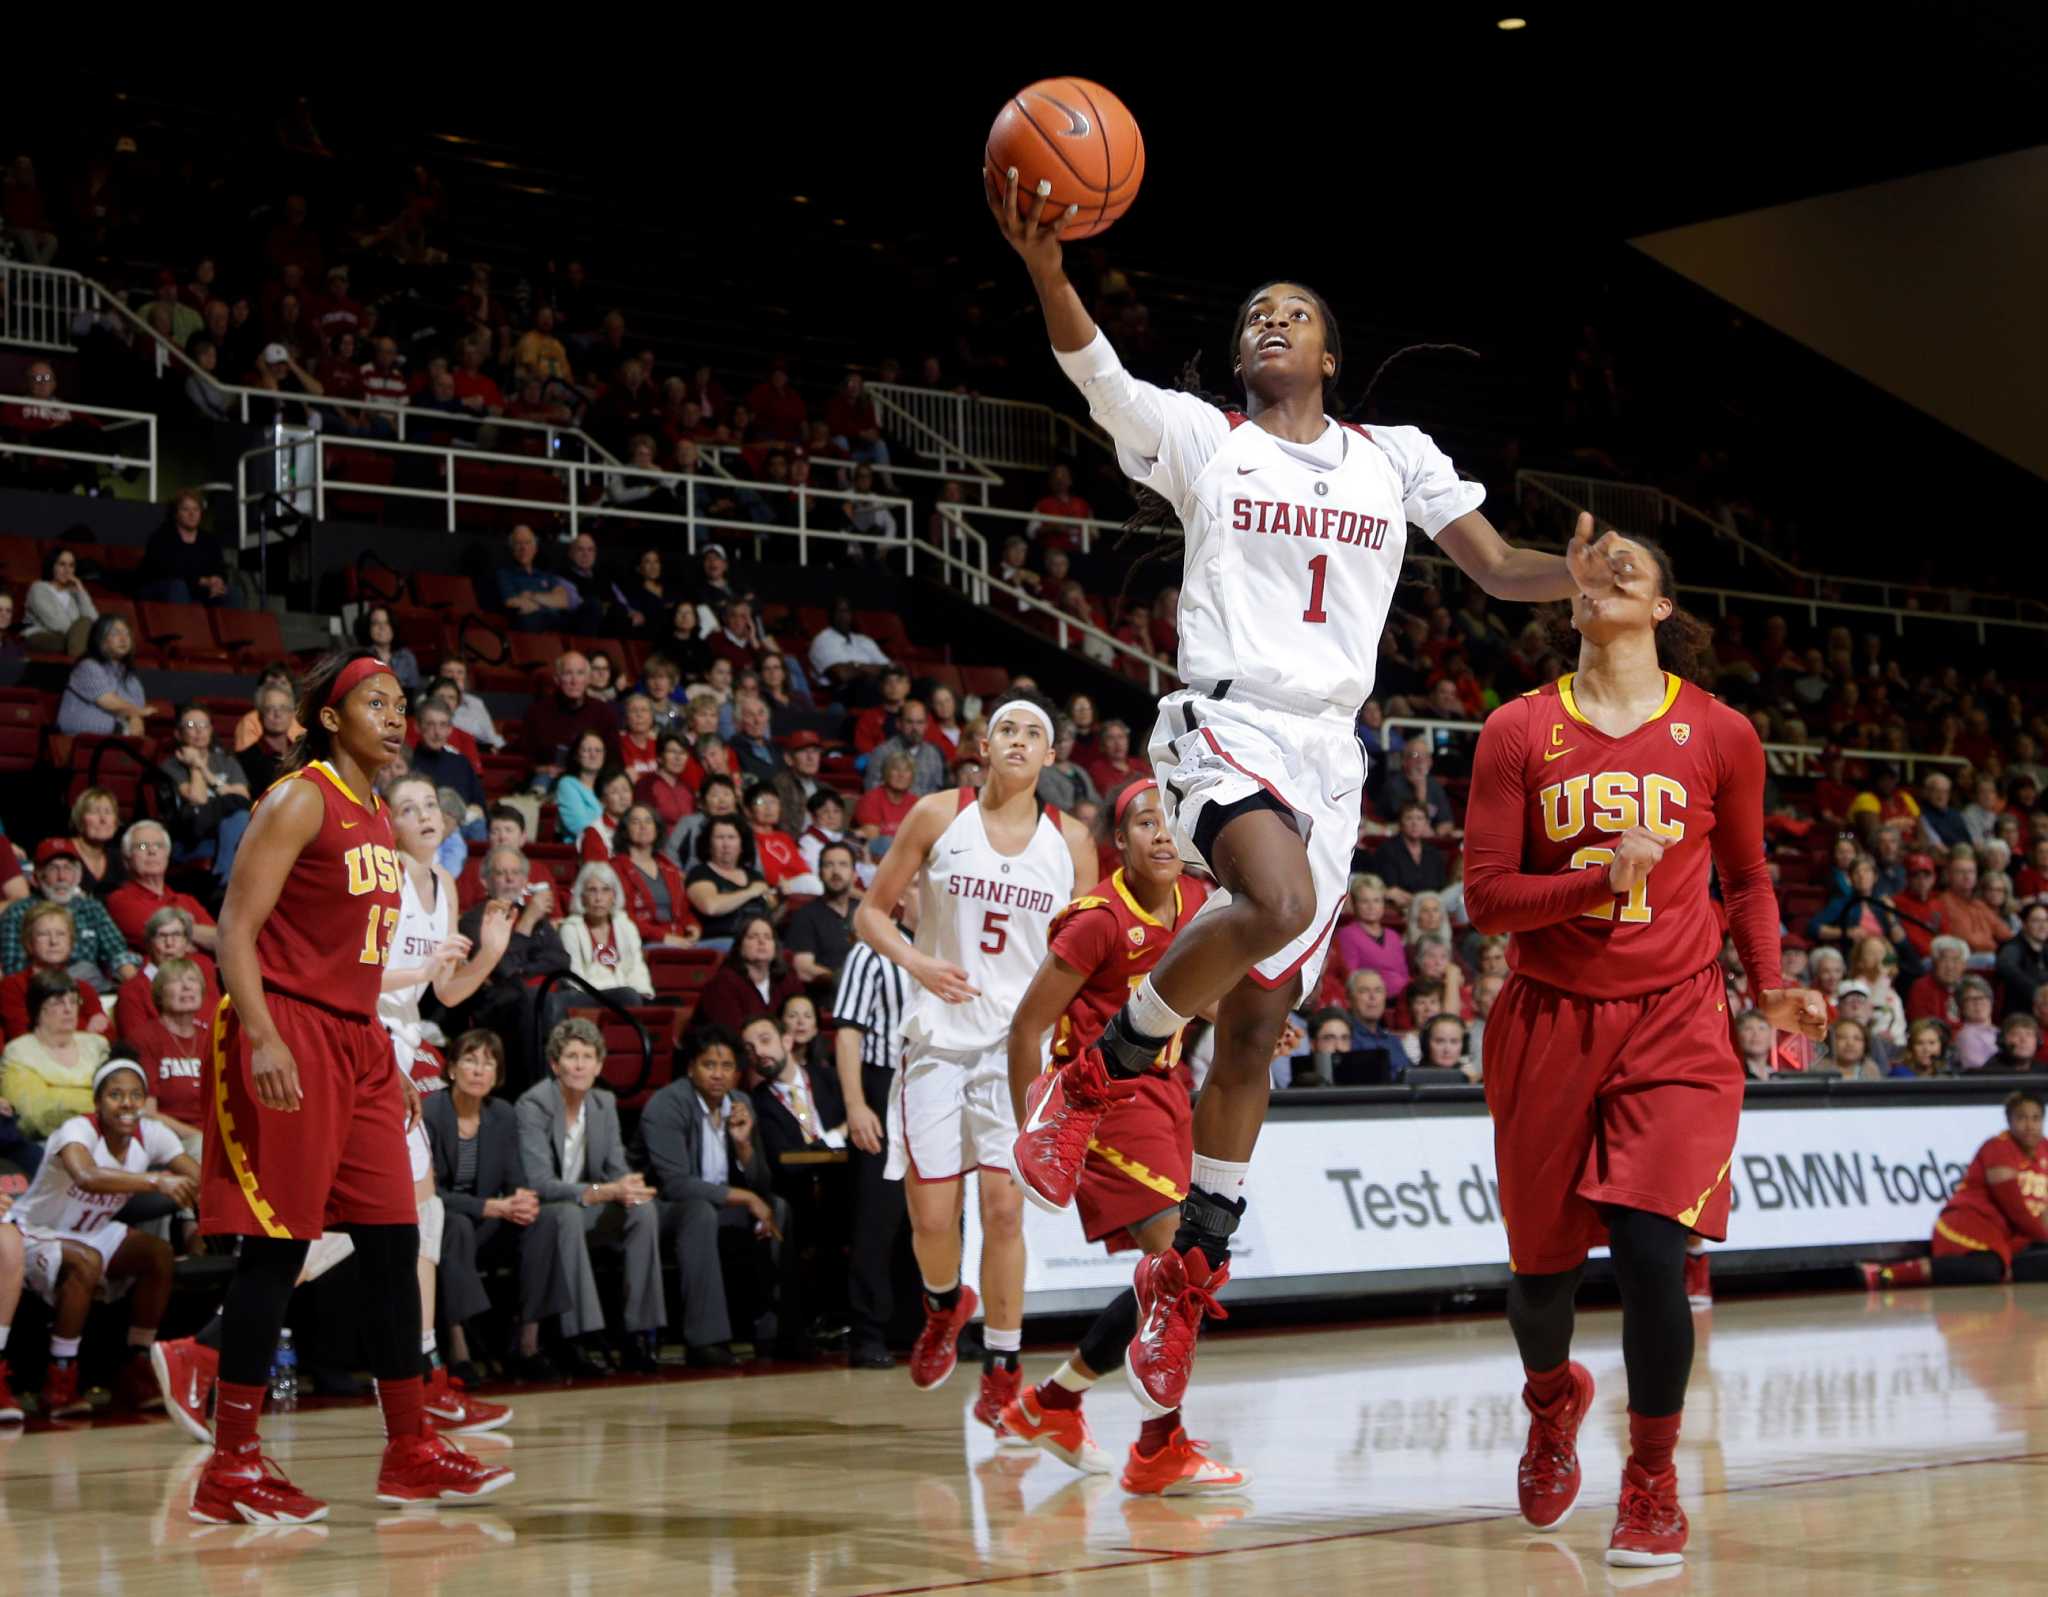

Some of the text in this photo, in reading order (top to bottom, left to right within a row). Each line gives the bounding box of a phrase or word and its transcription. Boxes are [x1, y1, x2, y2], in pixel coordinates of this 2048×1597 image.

[1232, 498, 1389, 551] STANFORD
[1303, 554, 1328, 623] 1
[1552, 723, 1565, 746] C
[1539, 771, 1687, 842] USC
[344, 842, 400, 896] US
[948, 874, 1054, 914] STANFORD
[980, 910, 1010, 956] 5
[1324, 1168, 1452, 1231] Test
[1741, 1151, 1868, 1210] BMW
[1871, 1148, 1968, 1206] toda
